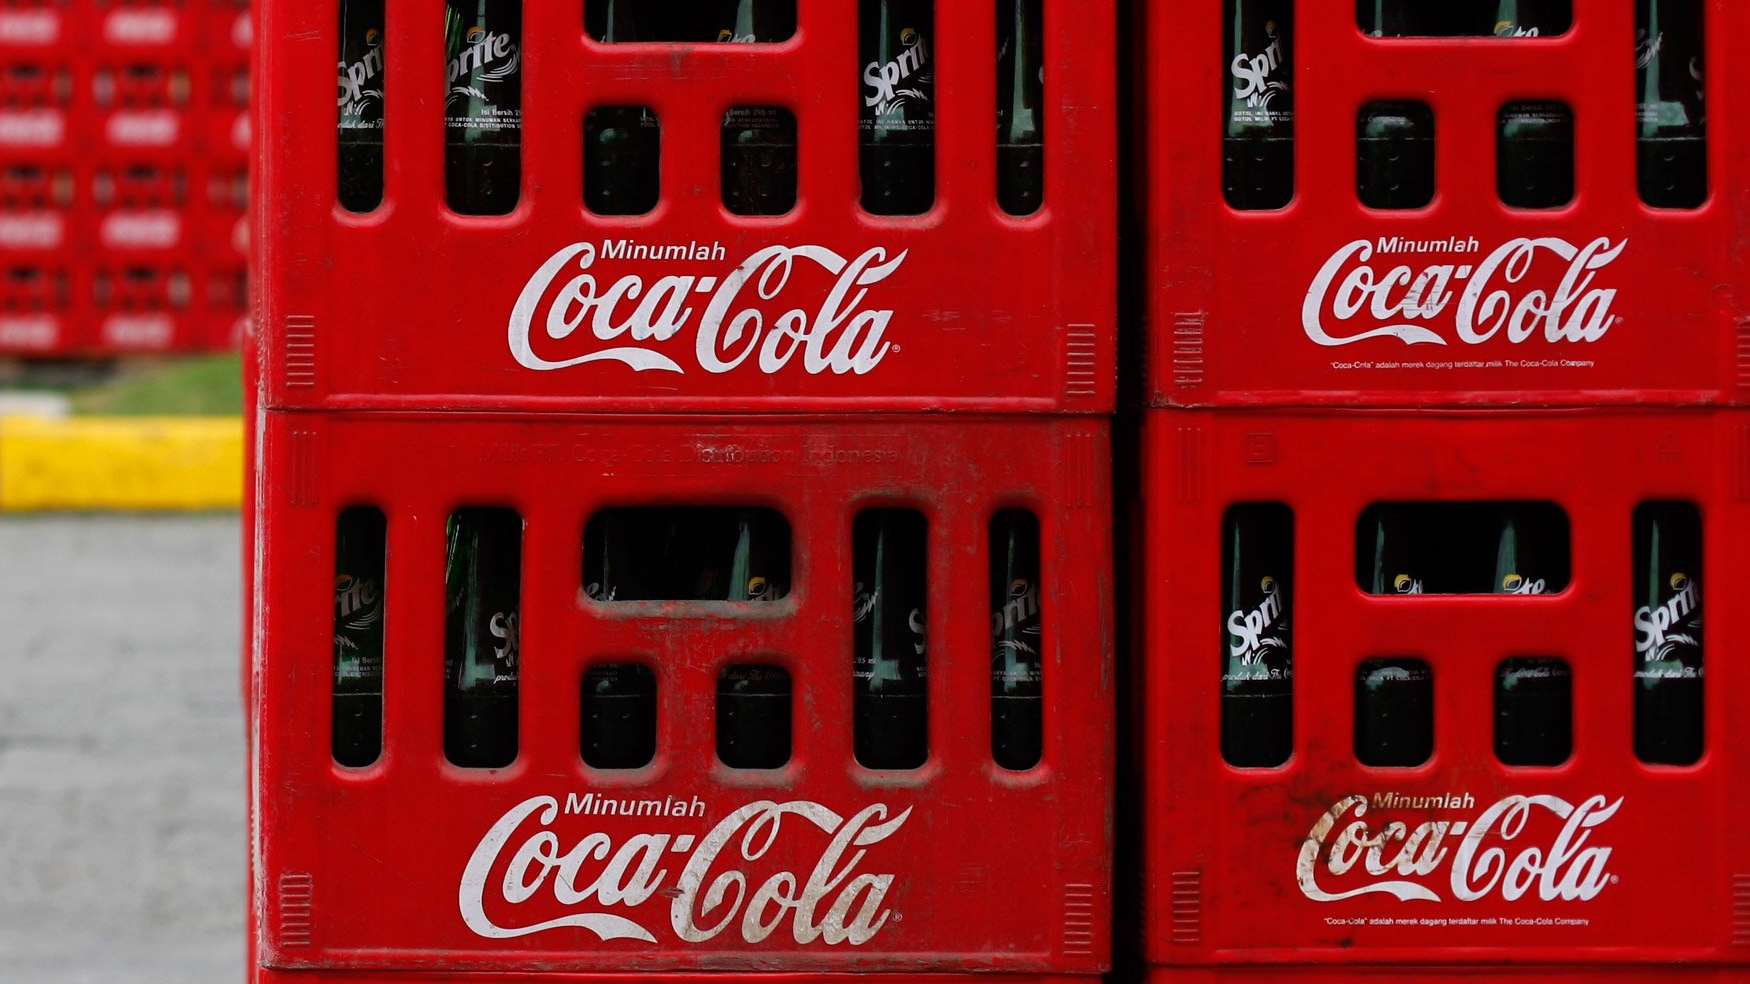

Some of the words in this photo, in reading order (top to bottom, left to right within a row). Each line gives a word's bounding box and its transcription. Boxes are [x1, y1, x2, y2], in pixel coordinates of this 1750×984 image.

[601, 240, 725, 260] Minumlah
[1377, 236, 1478, 253] Minumlah
[1375, 361, 1400, 369] adalah
[1426, 361, 1453, 370] dagang
[1505, 359, 1519, 367] The
[1520, 359, 1558, 367] Coca-Cola
[1560, 359, 1595, 368] Company
[565, 793, 705, 816] Minumlah
[1371, 793, 1474, 809] Minumlah
[1370, 917, 1394, 925] adalah
[1396, 917, 1418, 925] merek
[1420, 917, 1447, 927] dagang
[1499, 917, 1513, 925] The
[1514, 917, 1553, 925] Coca-Cola
[1554, 917, 1590, 926] Company
